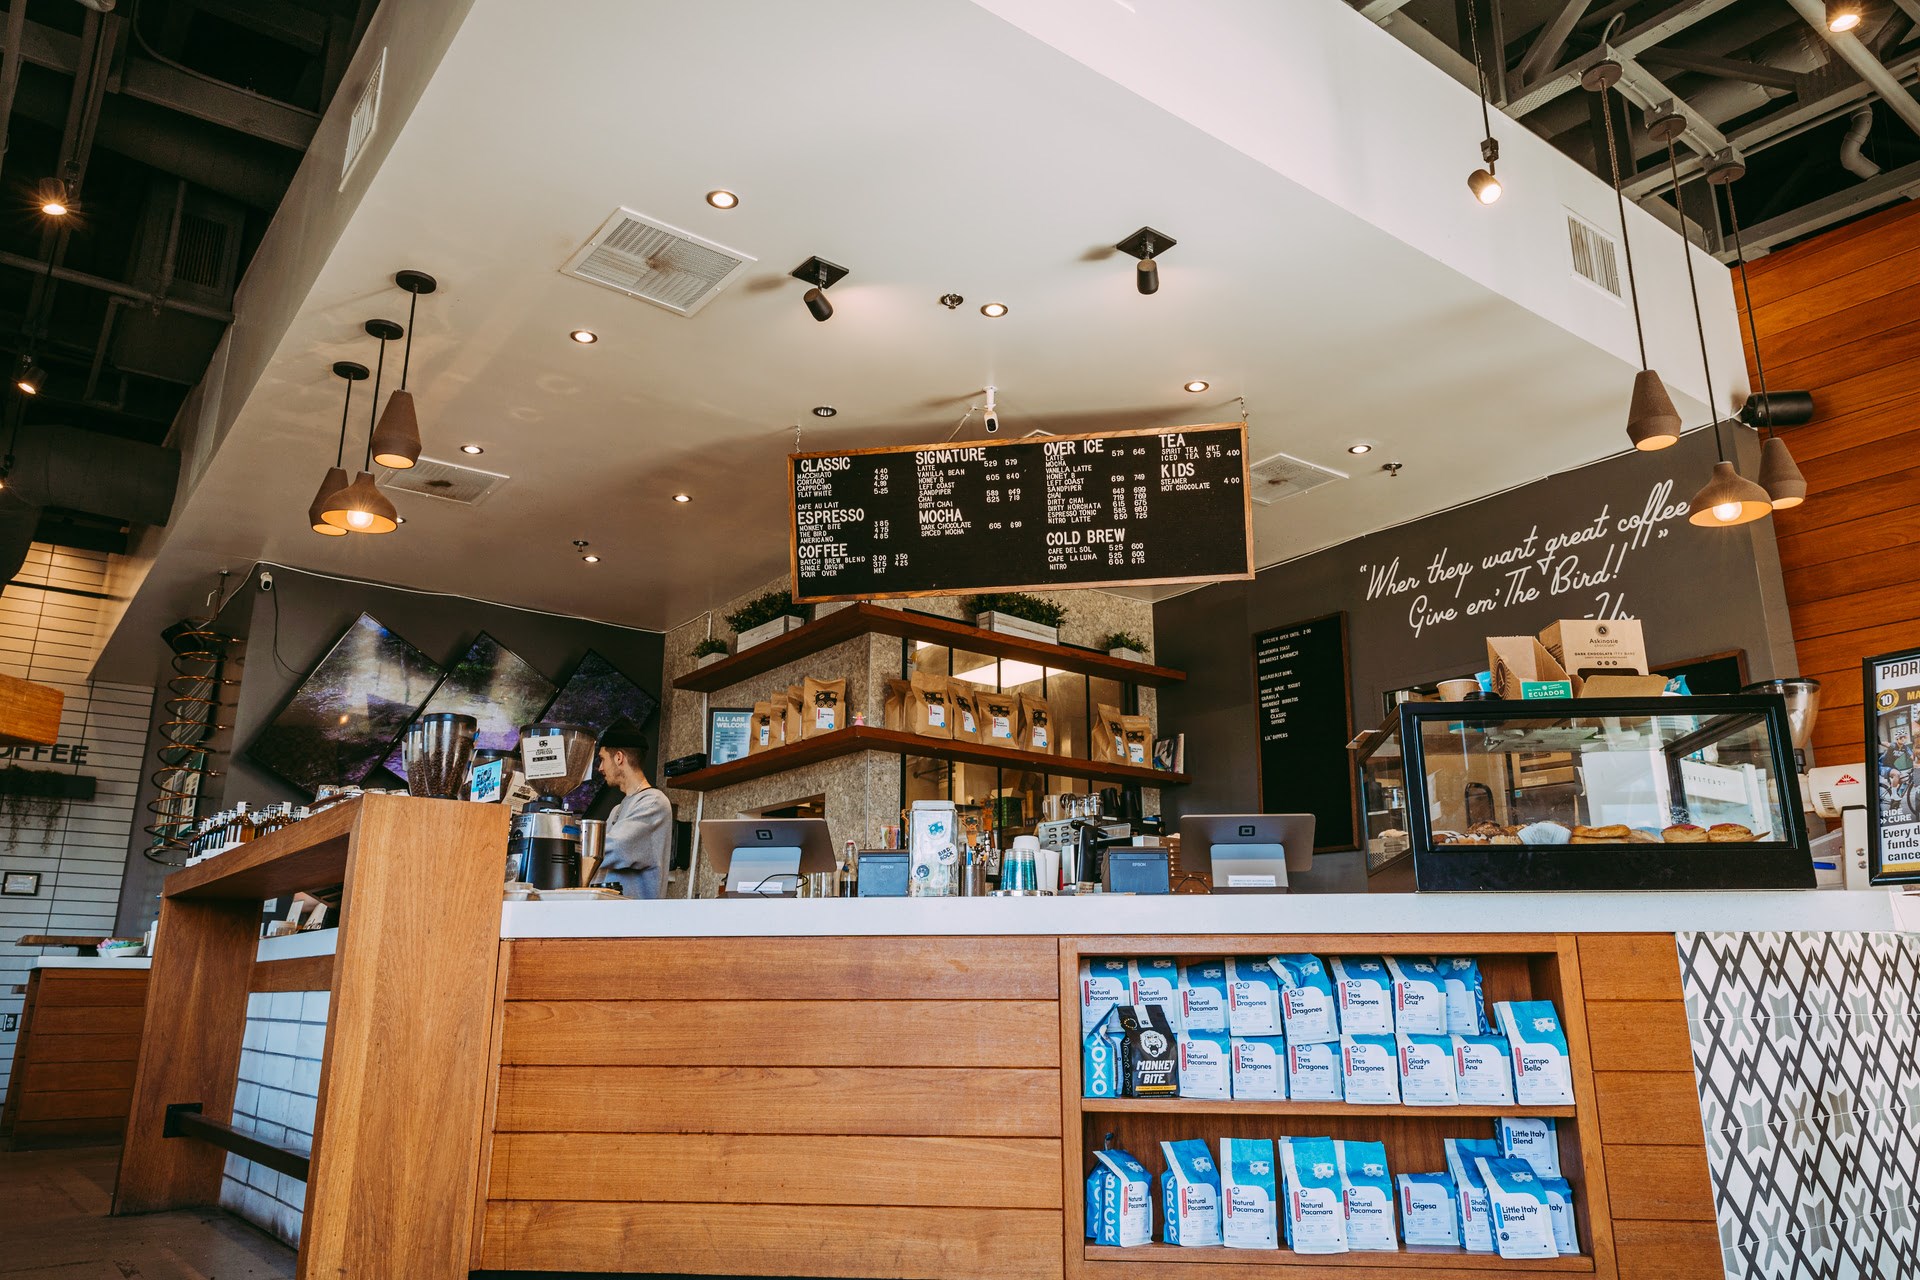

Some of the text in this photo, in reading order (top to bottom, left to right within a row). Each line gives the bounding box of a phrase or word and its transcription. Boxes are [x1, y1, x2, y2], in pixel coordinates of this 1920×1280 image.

[1159, 434, 1186, 448] TEA
[1044, 439, 1104, 456] OVER ICE
[916, 448, 986, 465] SIGNATURE
[1161, 454, 1178, 462] ICED
[801, 457, 851, 472] CLASSIC
[1046, 466, 1070, 474] VANILLA
[1161, 463, 1195, 478] KIDS
[797, 472, 831, 480] MACCHIATO
[797, 478, 825, 486] CORTADO
[1176, 482, 1210, 491] CHOCOLATE
[797, 484, 831, 492] CAPPUCINO
[1047, 485, 1082, 493] SANDPIPER
[1068, 503, 1101, 511] HORCHATA
[798, 508, 865, 525] ESPRESSO
[919, 508, 963, 524] MOCHA
[1048, 510, 1077, 518] ESPRESSO
[937, 522, 971, 530] CHOCOLATE
[801, 536, 834, 544] AMERICANO
[1047, 528, 1125, 546] COLD BREW
[1428, 548, 1473, 599] they
[1483, 525, 1537, 571] want
[1538, 504, 1609, 575] great
[1618, 479, 1691, 550] coffee
[799, 543, 848, 559] COFFEE
[845, 556, 865, 564] BLEND
[1409, 595, 1458, 639] Give
[1505, 566, 1540, 608] The
[1882, 660, 1920, 680] PADR
[1881, 694, 1892, 706] 10
[1883, 808, 1903, 817] RIDE
[1889, 814, 1912, 823] CURE
[1883, 828, 1910, 838] Every
[1888, 838, 1919, 849] funds
[938, 847, 950, 856] BIRD
[940, 852, 954, 861] ROCK
[1292, 1007, 1323, 1015] Dragones
[1136, 1060, 1175, 1073] MONKEY
[1409, 1058, 1430, 1067] Gladys
[1523, 1057, 1549, 1067] Campo
[1241, 1063, 1272, 1071] Dragones
[1352, 1065, 1385, 1073] Dragones
[1524, 1064, 1542, 1072] Bello
[1143, 1074, 1166, 1084] BITE
[1512, 1130, 1546, 1140] Little Italy
[1233, 1206, 1264, 1214] Pacamara
[1413, 1203, 1437, 1211] Gigesa
[1521, 1205, 1538, 1214] Italy
[1301, 1208, 1333, 1216] Pacamara
